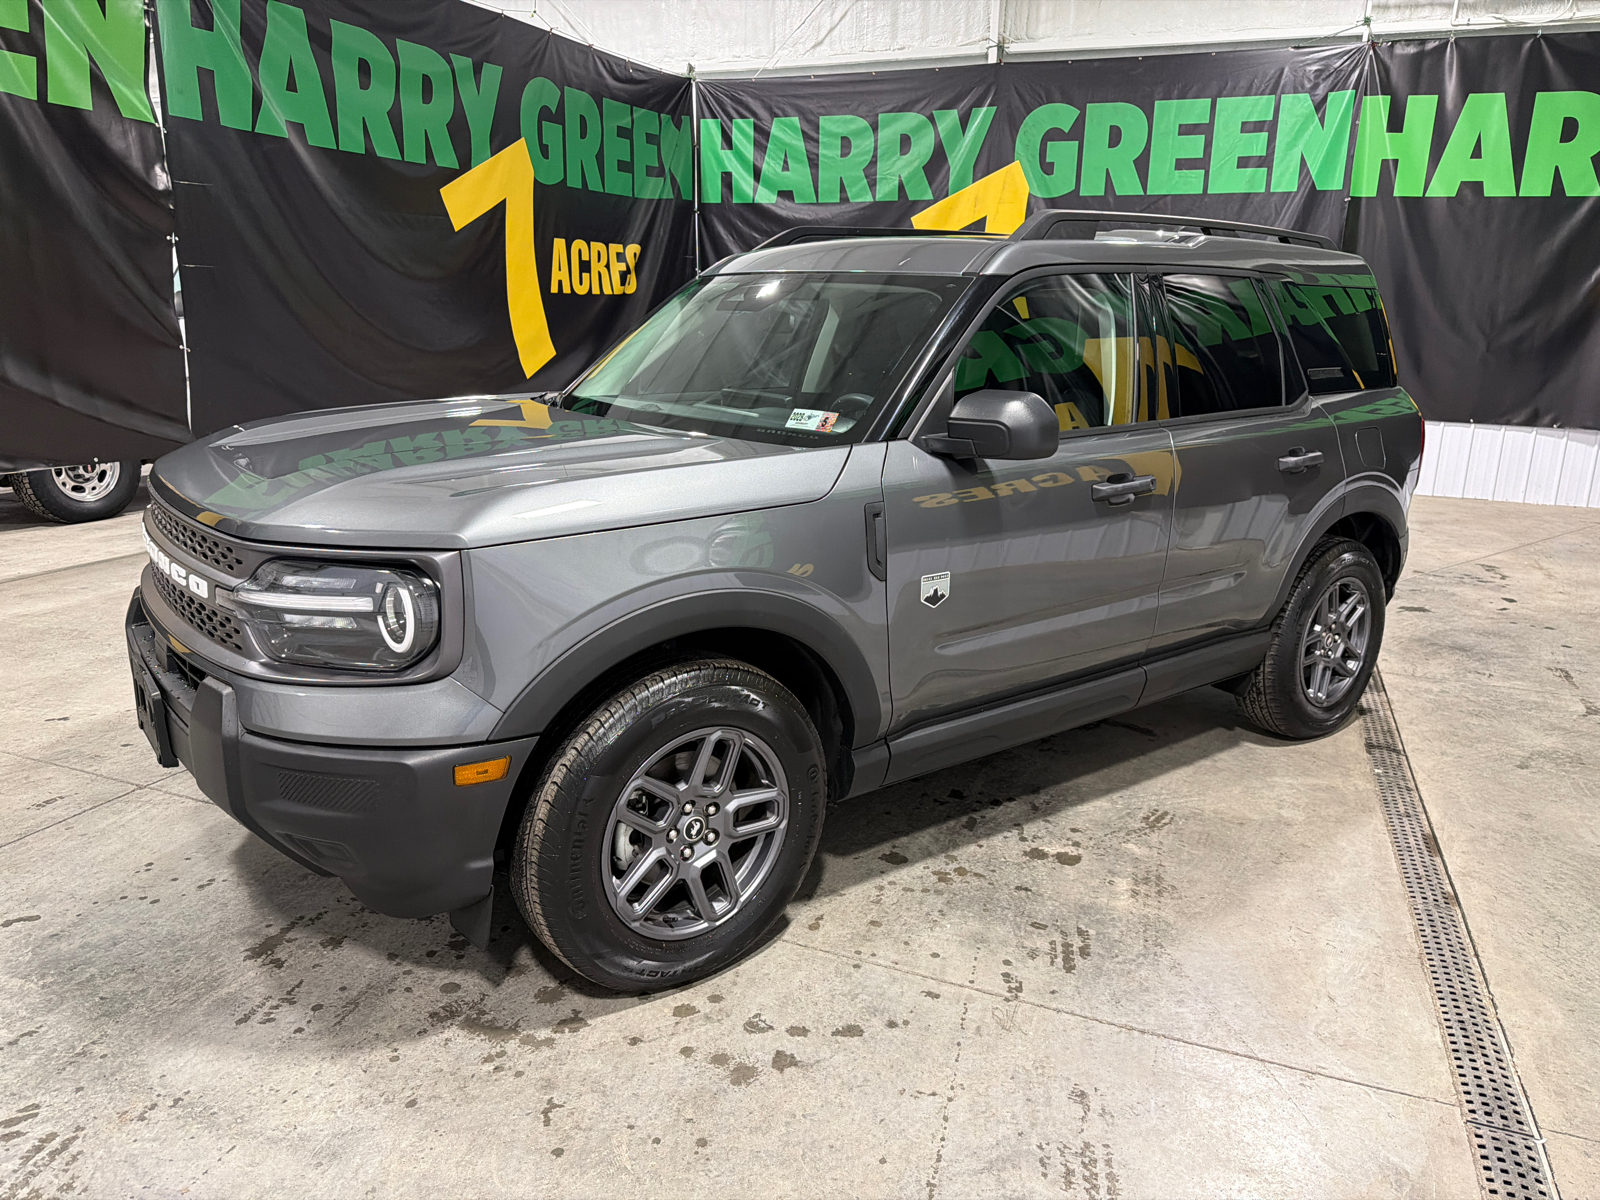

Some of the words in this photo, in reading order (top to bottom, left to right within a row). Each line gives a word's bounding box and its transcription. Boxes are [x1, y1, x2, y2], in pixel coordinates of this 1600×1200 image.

[155, 0, 504, 169] HARRY
[520, 76, 693, 200] GREEN
[700, 105, 997, 204] HARRY
[1014, 89, 1356, 199] GREEN
[440, 137, 557, 379] 7
[550, 237, 641, 296] ACRES
